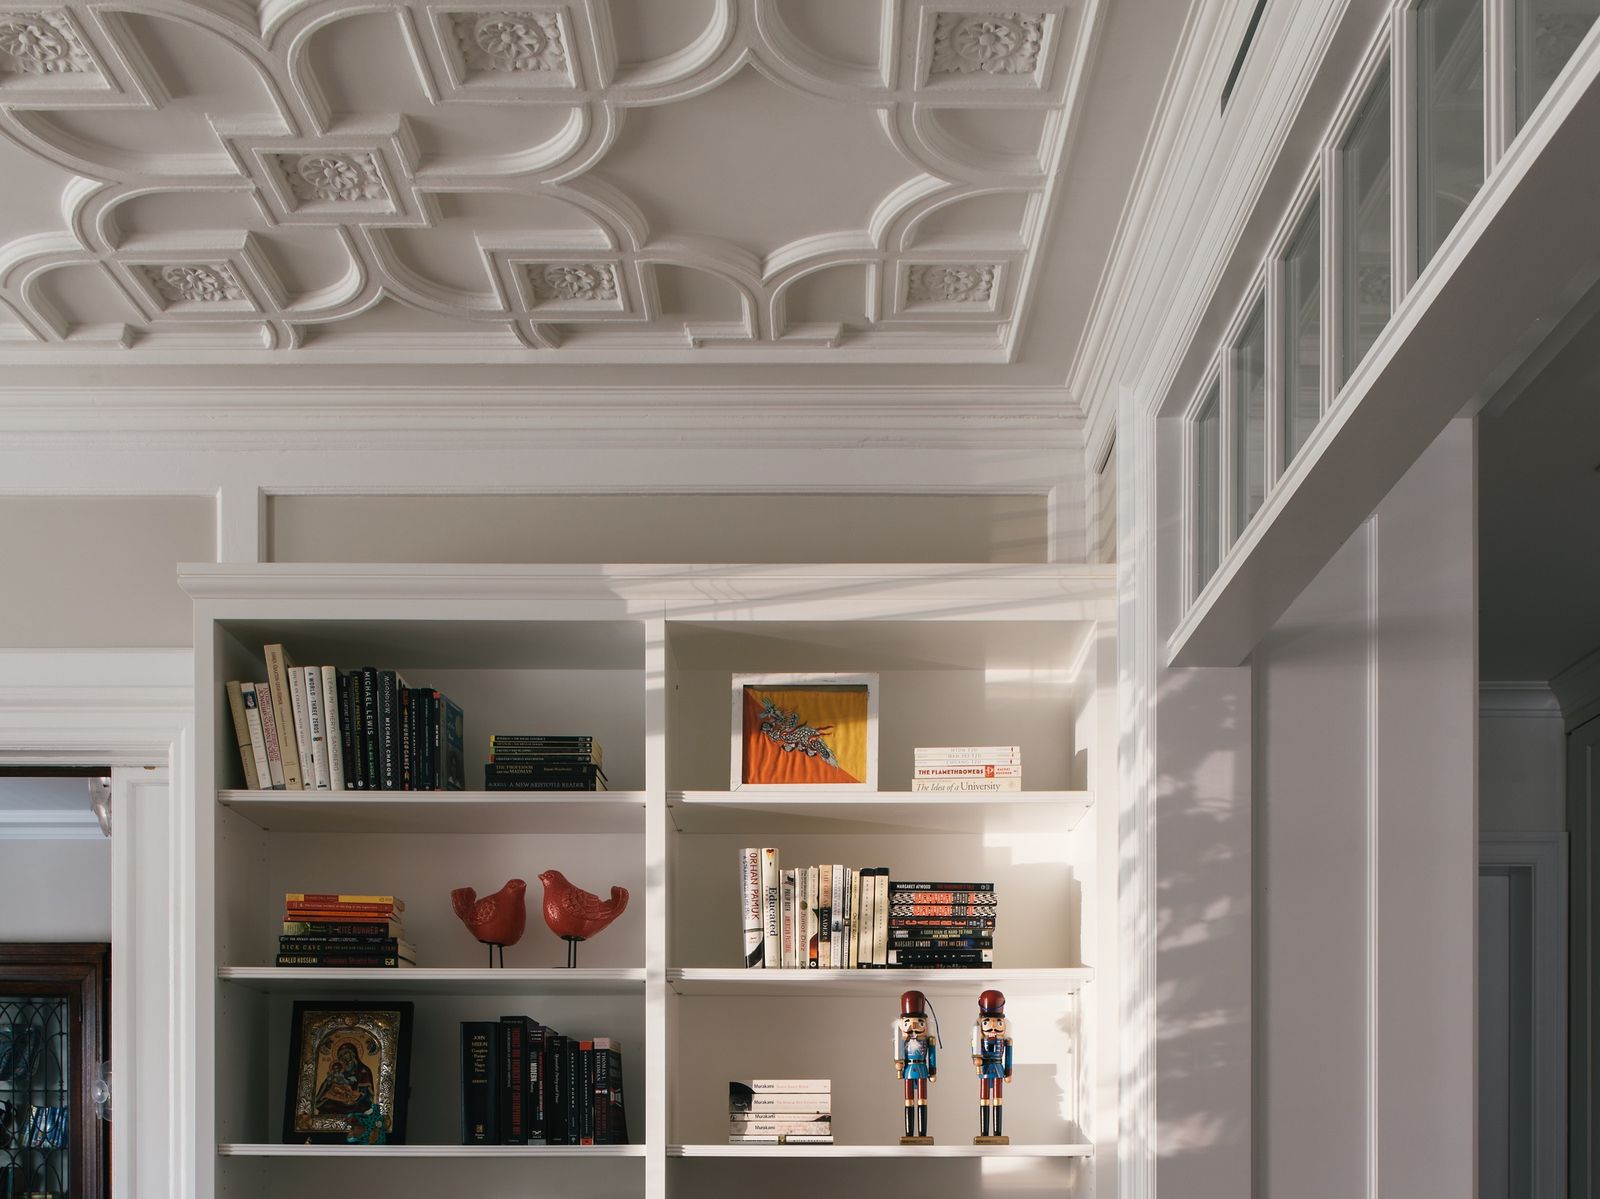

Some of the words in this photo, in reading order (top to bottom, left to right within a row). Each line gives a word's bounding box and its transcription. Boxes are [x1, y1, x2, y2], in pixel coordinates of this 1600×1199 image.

[308, 678, 316, 696] WORLD
[364, 671, 372, 707] MICHAEL
[311, 700, 319, 716] THREE
[313, 718, 321, 734] ZEROS
[366, 710, 374, 735] LEWIS
[331, 735, 339, 772] SANDBERG
[917, 783, 929, 791] The
[931, 783, 945, 791] Idea
[961, 782, 1001, 792] University
[749, 852, 758, 885] ORHAN
[751, 889, 760, 921] PAMUK
[768, 887, 778, 937] Educated
[530, 1063, 538, 1083] MODERN
